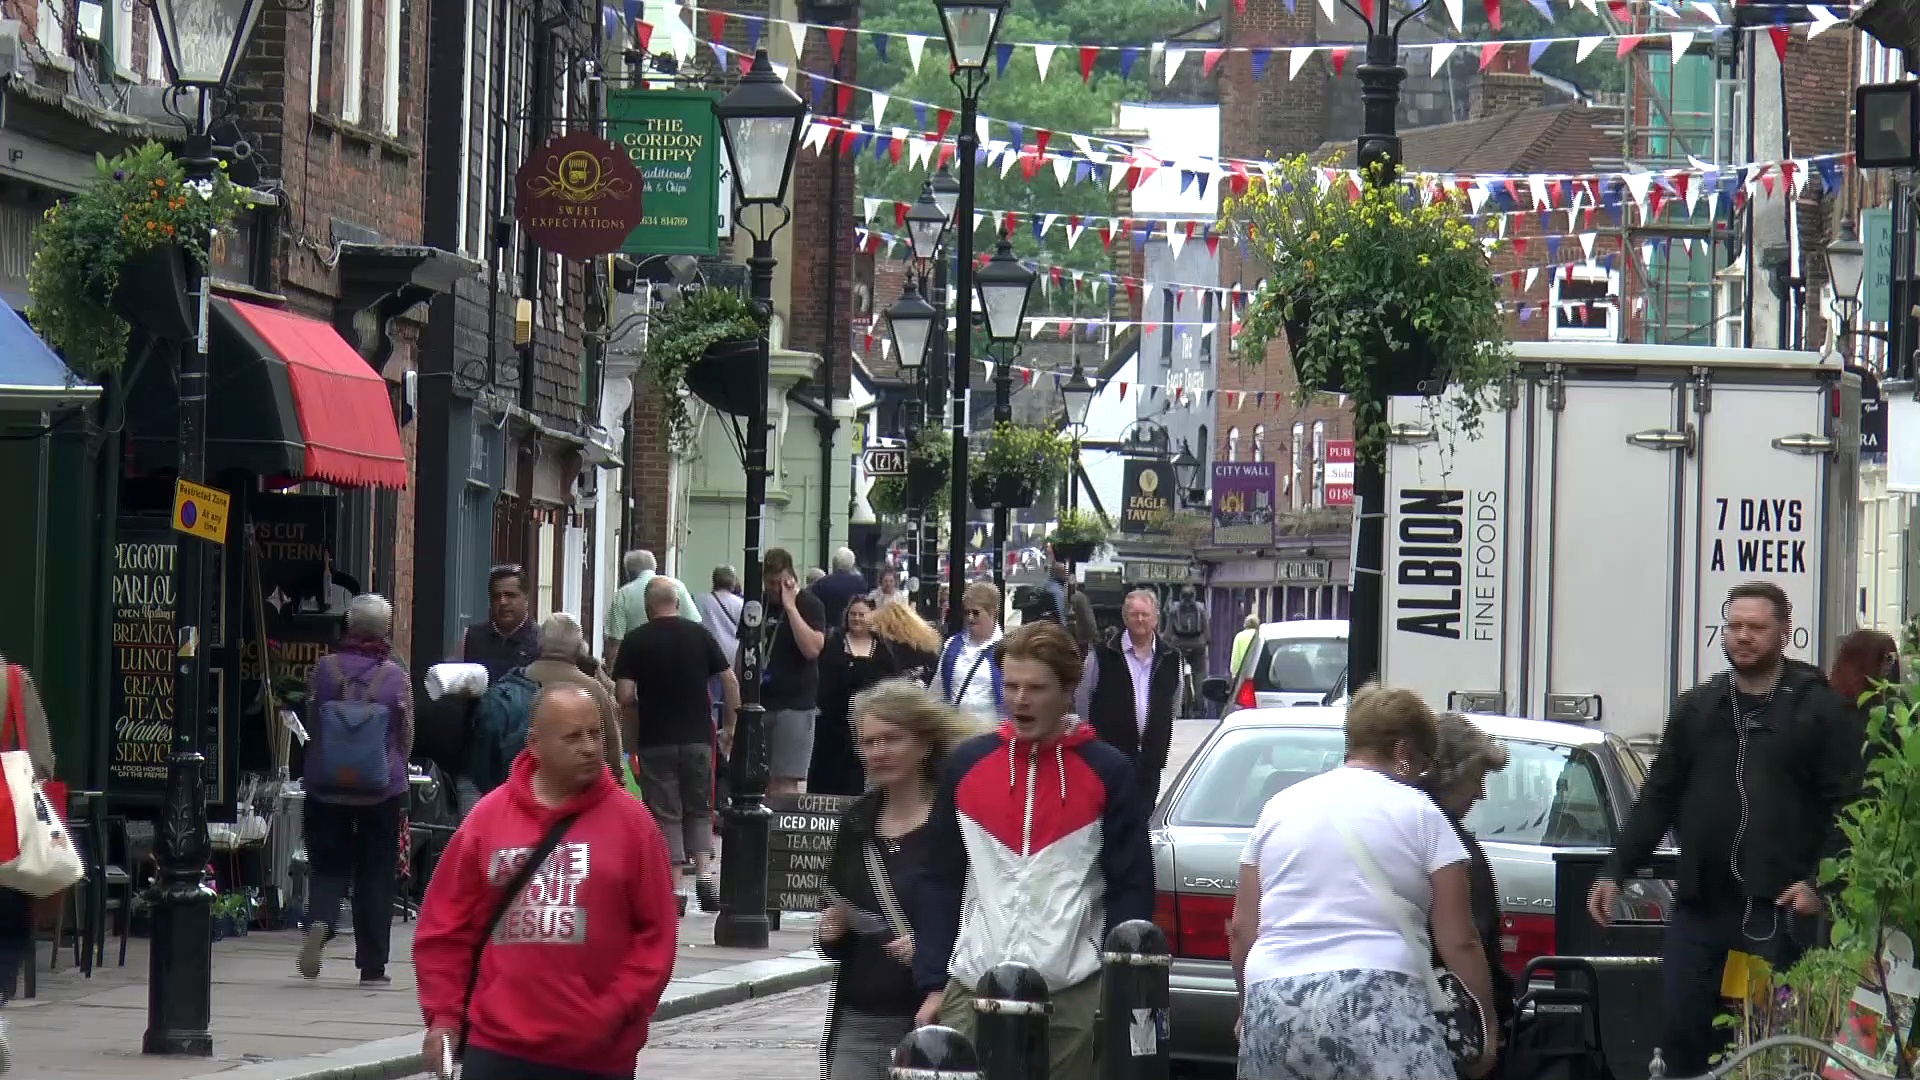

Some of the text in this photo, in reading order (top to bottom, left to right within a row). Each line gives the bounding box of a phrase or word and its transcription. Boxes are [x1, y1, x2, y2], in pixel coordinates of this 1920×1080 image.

[646, 118, 683, 132] THE
[623, 133, 702, 147] GORDON
[629, 148, 697, 162] CHIPPY
[558, 206, 599, 216] SWEET
[531, 219, 625, 230] EXPECTATIONS
[639, 216, 659, 226] 634
[1329, 447, 1351, 457] PUB
[1215, 465, 1271, 477] CITY WALL
[180, 484, 227, 508] Restricted Zone
[1130, 496, 1167, 509] EAGLE
[201, 509, 222, 524] At any
[1716, 498, 1802, 532] 7 DAYS
[203, 522, 217, 532] time
[1711, 539, 1806, 573] A WEEK
[1396, 489, 1464, 640] ALBION
[1474, 490, 1497, 641] FINE FOODS
[124, 696, 174, 720] TEAS
[797, 795, 840, 812] COFFEE
[780, 815, 806, 829] ICED
[786, 834, 808, 848] TEA
[1505, 896, 1527, 906] LS
